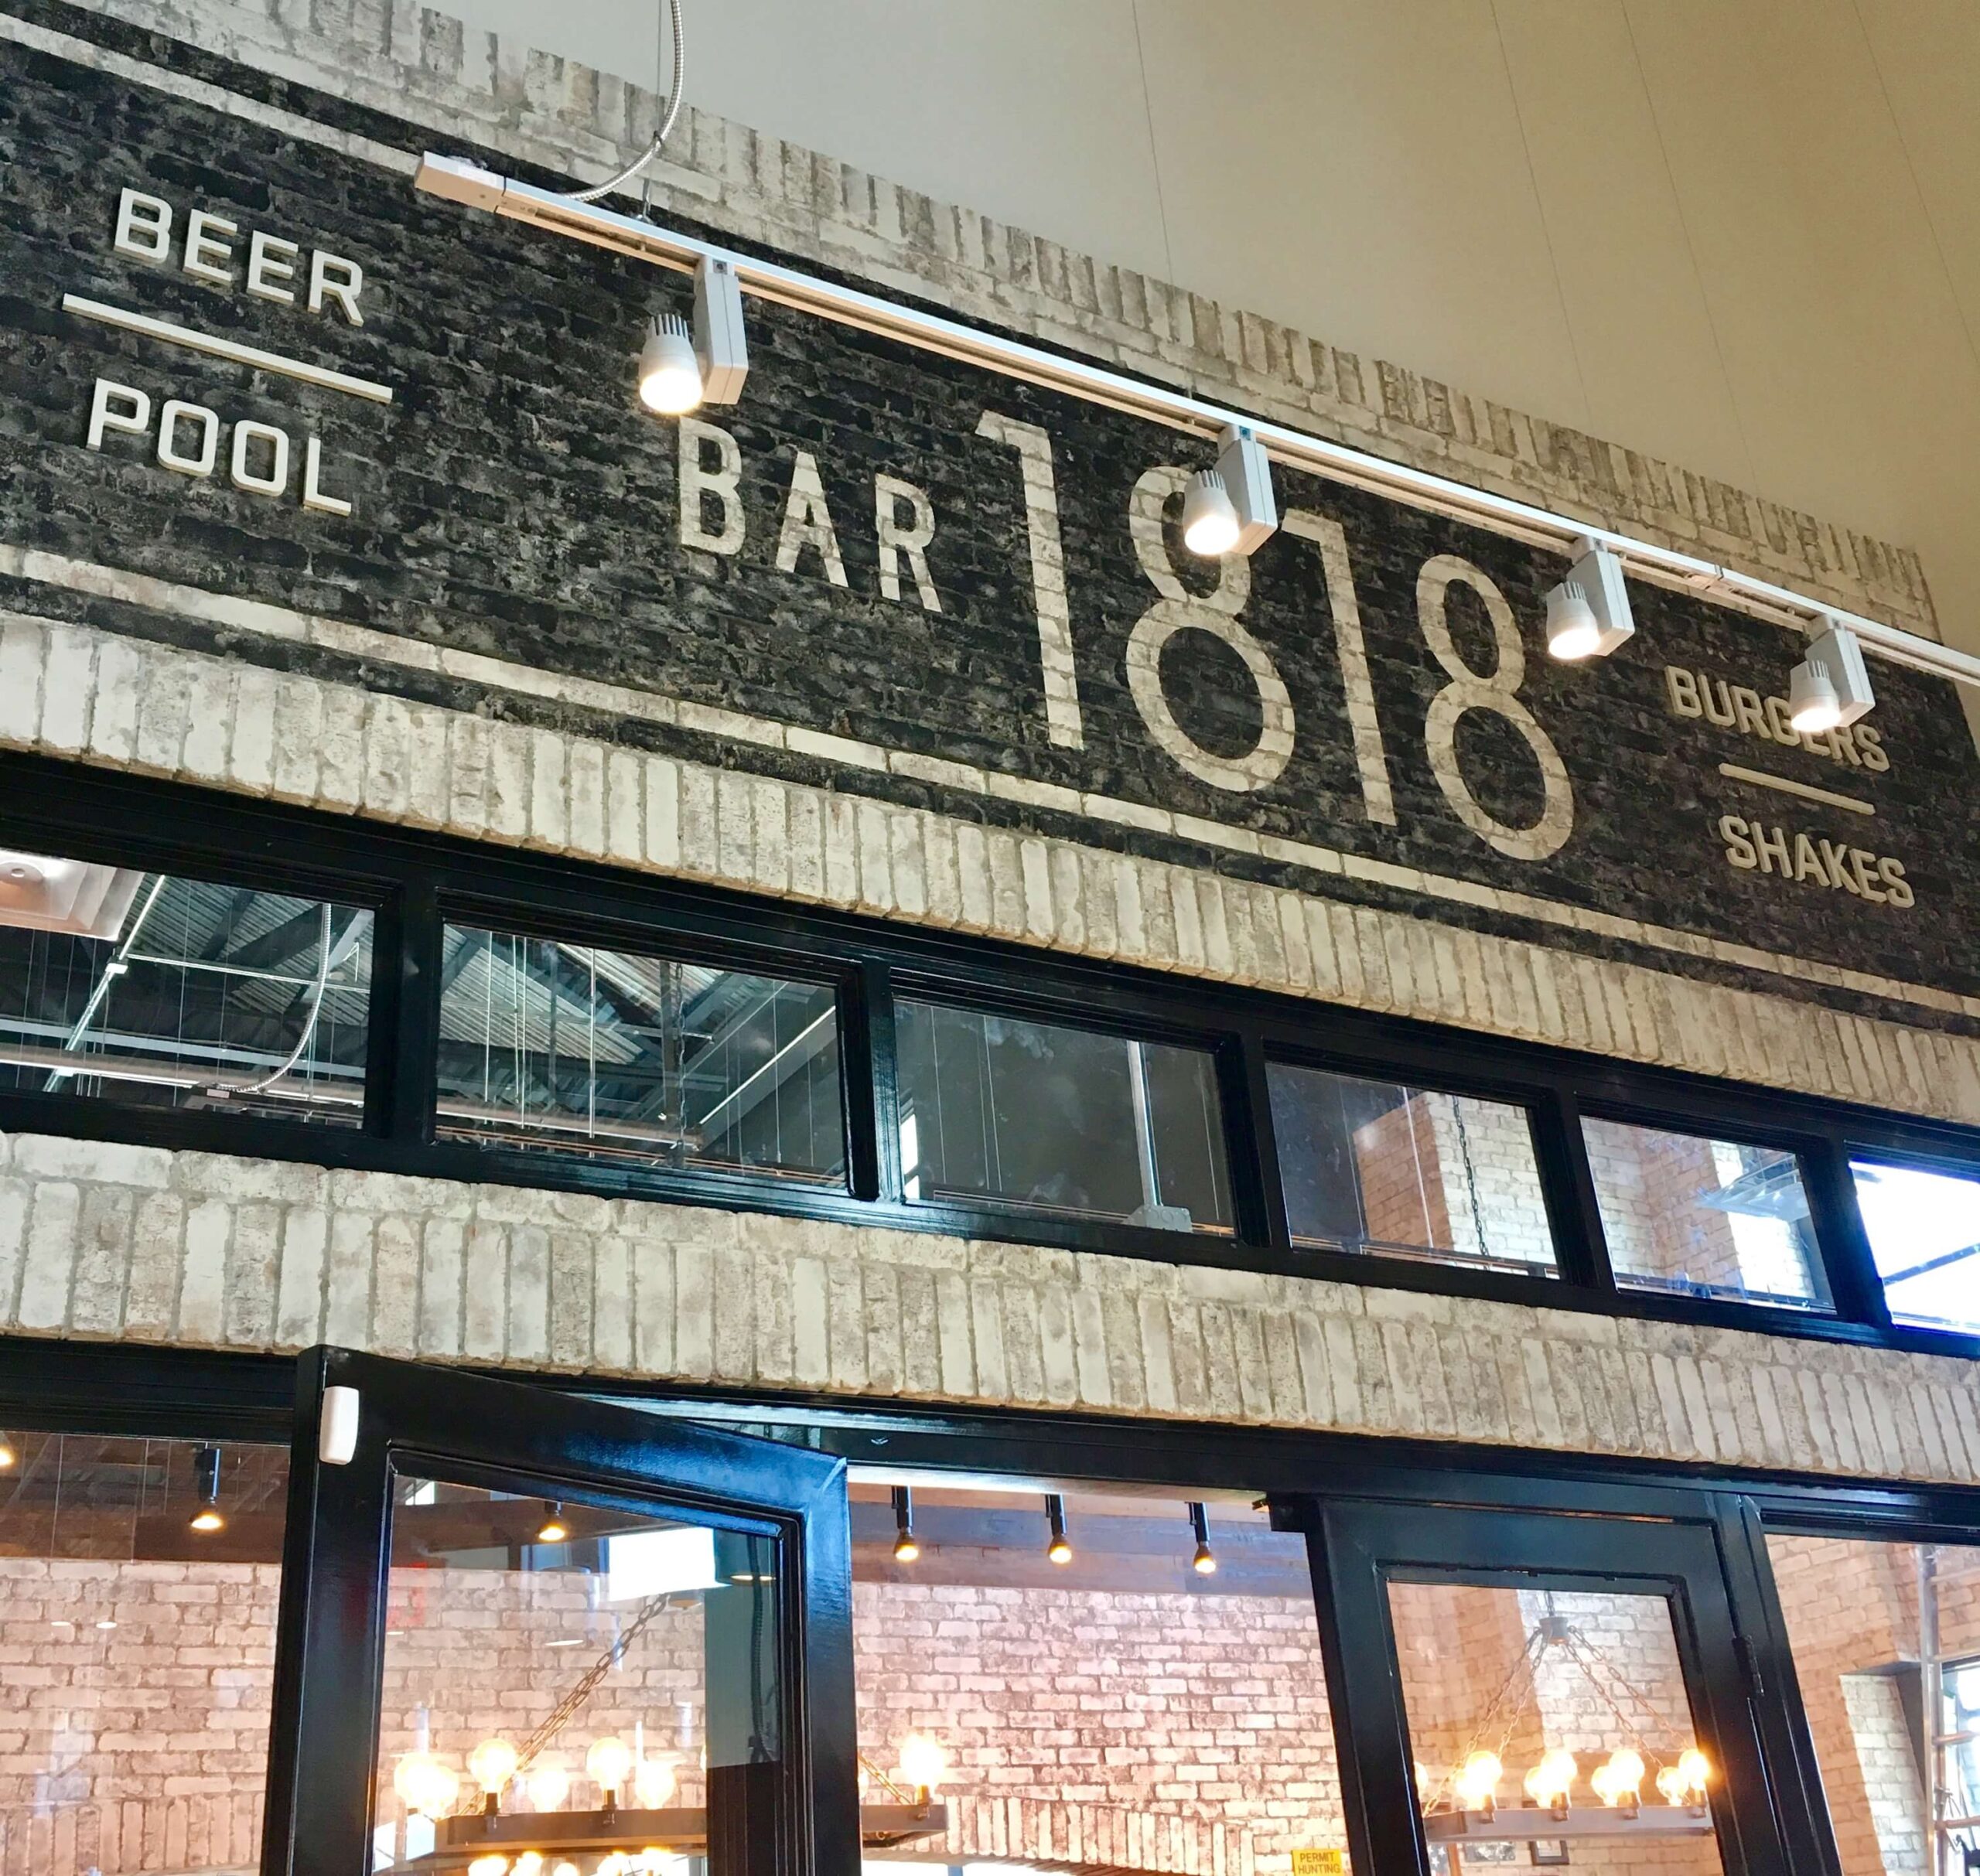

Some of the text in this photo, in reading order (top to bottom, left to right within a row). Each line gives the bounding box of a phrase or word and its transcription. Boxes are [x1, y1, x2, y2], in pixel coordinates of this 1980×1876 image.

[114, 186, 364, 326] BEER
[87, 379, 351, 517] POOL
[678, 409, 1574, 861] BAR 1818
[1719, 815, 1914, 908] SHAKES
[1298, 1864, 1340, 1874] HUNTING
[1300, 1852, 1334, 1862] PERMIT
